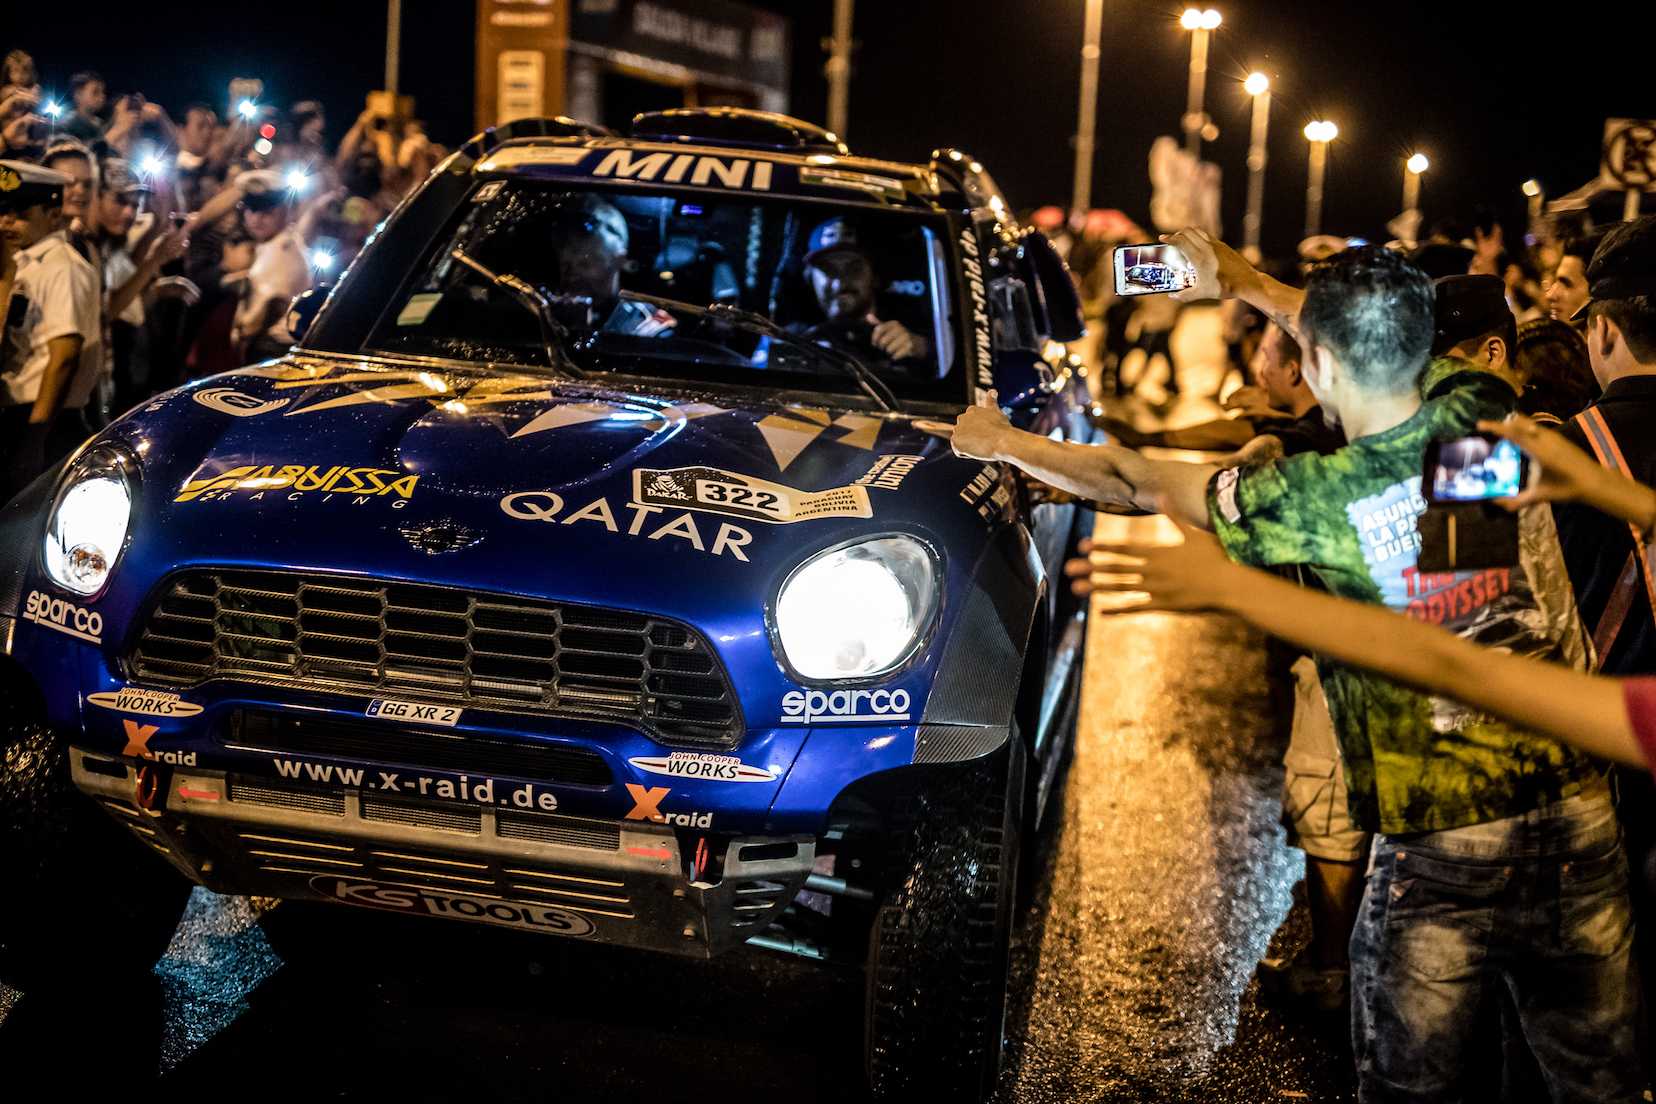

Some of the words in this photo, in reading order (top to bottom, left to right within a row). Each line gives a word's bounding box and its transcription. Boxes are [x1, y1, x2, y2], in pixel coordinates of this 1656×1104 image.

[592, 149, 774, 190] MINI
[959, 229, 993, 386] www.x-raid.de
[217, 491, 409, 510] RACING
[646, 487, 690, 501] DAKAR
[704, 484, 780, 512] 322
[795, 505, 858, 517] ARGENTINA
[814, 500, 857, 508] BOLIVIA
[500, 491, 753, 563] QATAR
[1367, 525, 1394, 547] LA
[25, 590, 103, 638] sparco
[120, 687, 144, 699] JOHN
[145, 689, 180, 702] COOPER
[115, 695, 177, 714] WORKS
[381, 702, 409, 716] GG
[411, 705, 438, 720] XR
[440, 709, 455, 721] 2
[781, 688, 911, 724] sparco
[668, 752, 700, 761] JOHN
[701, 753, 740, 766] COOPER
[668, 760, 738, 779] WORKS
[273, 758, 559, 811] www.x-raid.de
